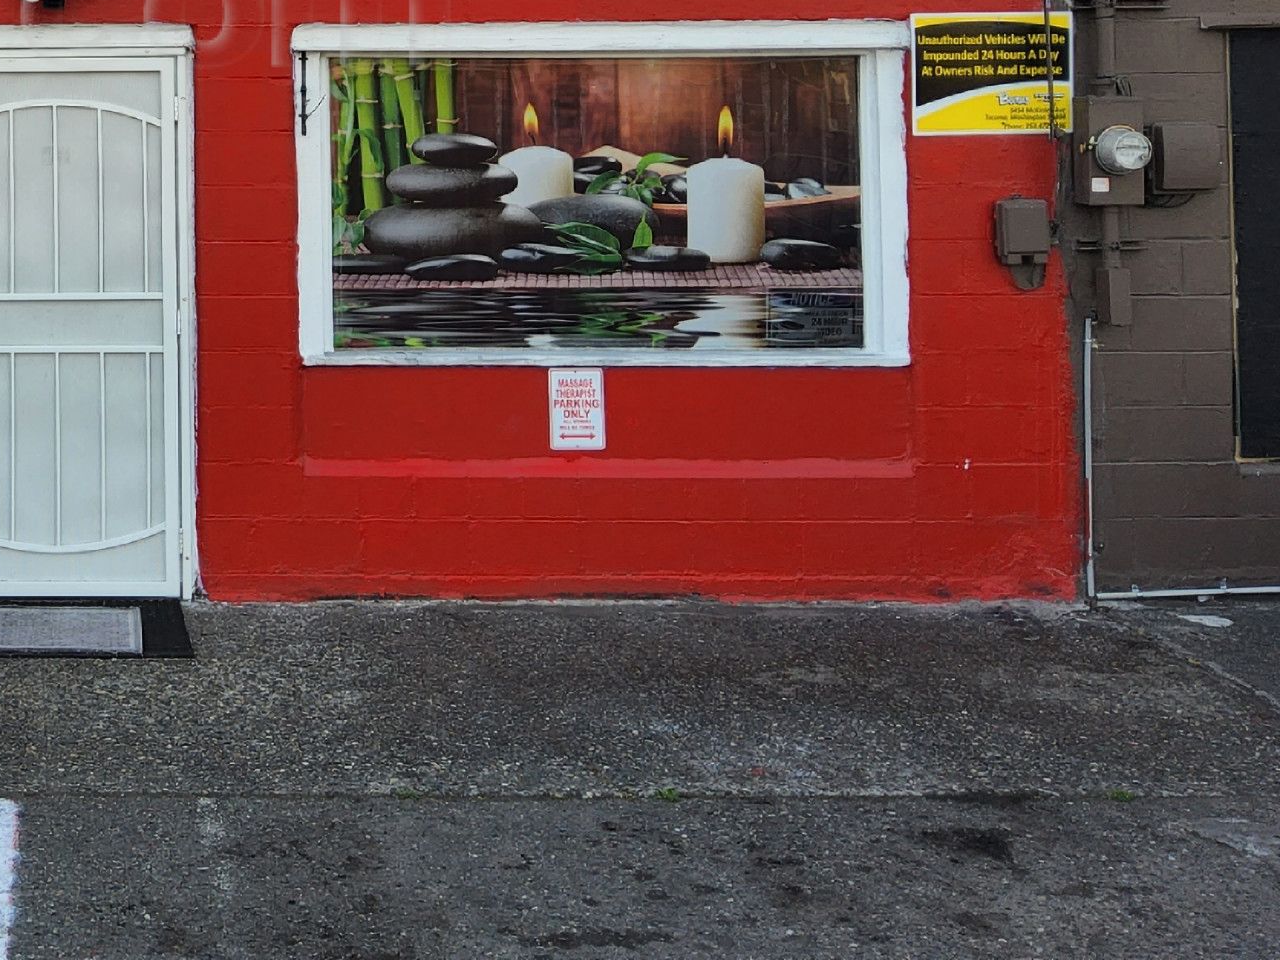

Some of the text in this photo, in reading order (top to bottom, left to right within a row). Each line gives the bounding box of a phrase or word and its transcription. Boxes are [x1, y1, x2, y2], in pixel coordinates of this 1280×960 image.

[917, 33, 982, 44] Unauthorized
[984, 33, 1026, 44] Vehicles
[1051, 33, 1065, 44] Be
[923, 50, 979, 63] Impounded
[981, 50, 994, 60] 24
[996, 50, 1026, 60] Hours
[1029, 50, 1037, 59] A
[921, 65, 933, 76] At
[935, 65, 972, 76] Owners
[974, 65, 994, 75] Risk
[997, 65, 1018, 75] And
[791, 292, 834, 306] NOTICE
[558, 378, 593, 388] MASSAGE
[553, 399, 600, 408] PARKING
[563, 409, 590, 418] ONLY
